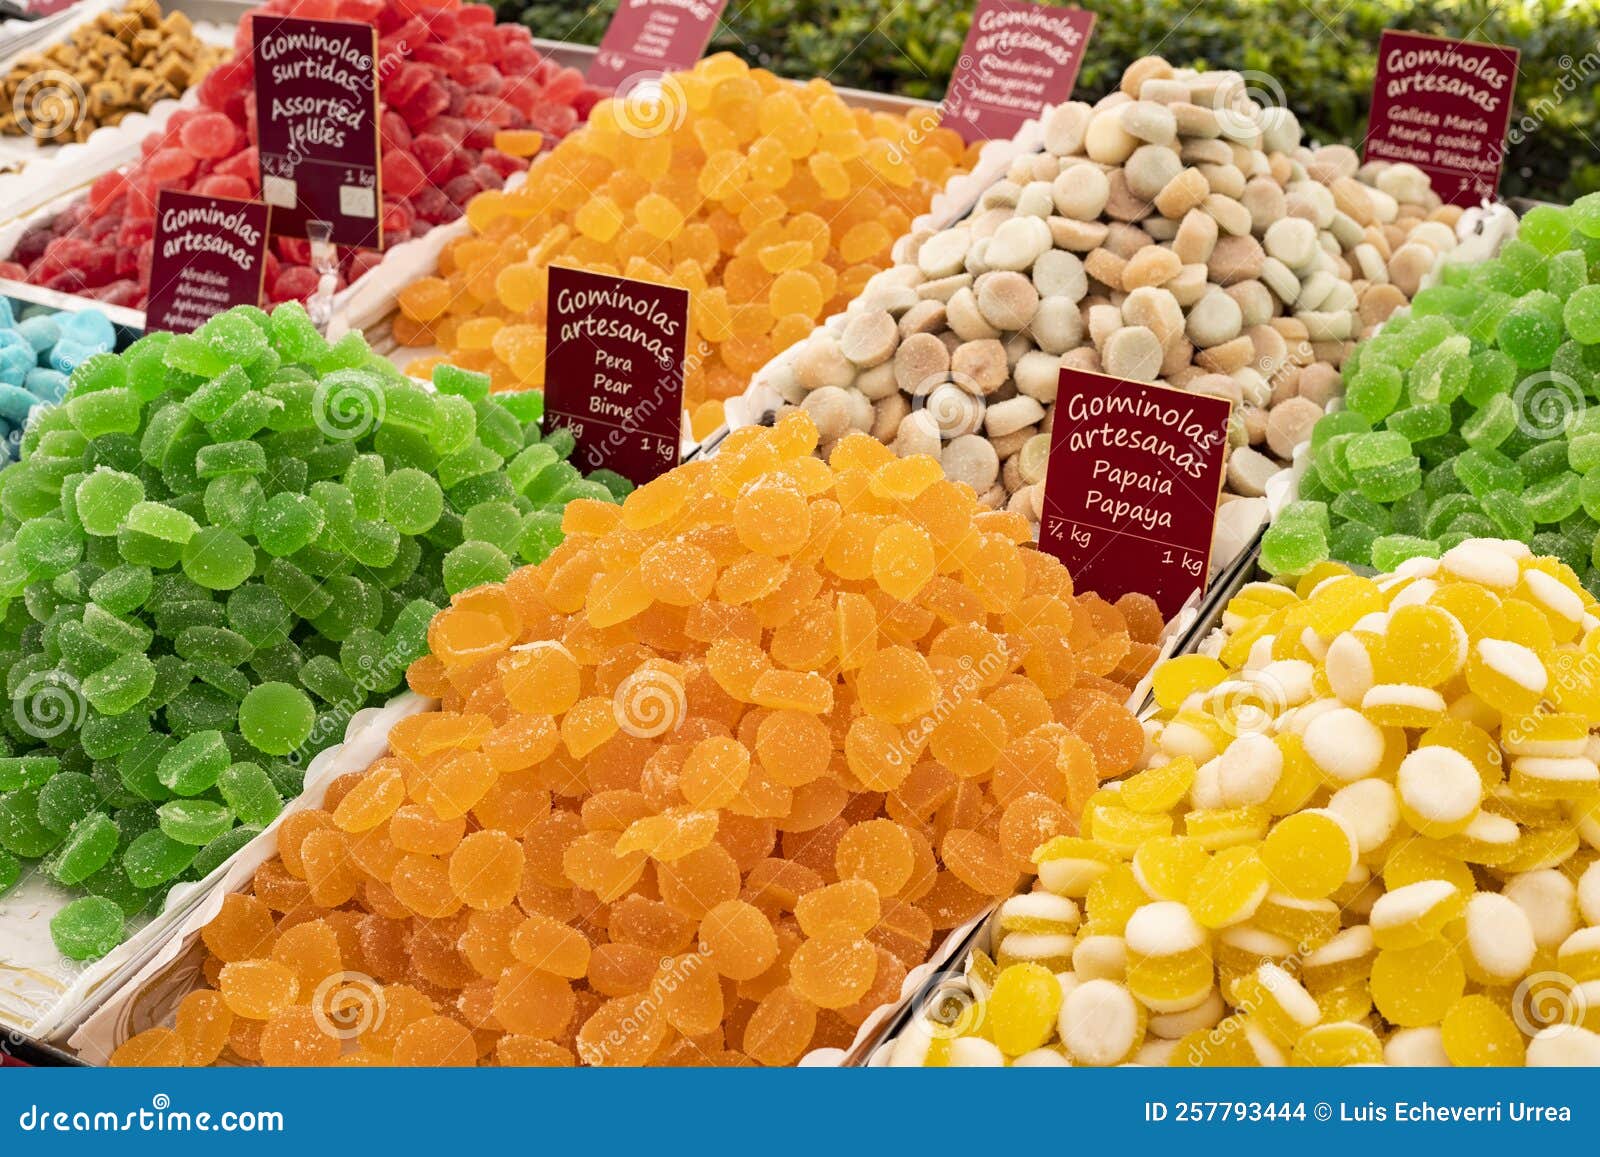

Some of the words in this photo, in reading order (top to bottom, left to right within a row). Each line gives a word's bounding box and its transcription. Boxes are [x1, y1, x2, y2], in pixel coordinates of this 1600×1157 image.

[978, 6, 1083, 46] Gominolas
[976, 29, 1073, 66] artesanas
[272, 55, 361, 91] surtidas
[1386, 43, 1509, 90] Gominolas
[1386, 70, 1501, 113] artesanas
[272, 96, 366, 131] Assorted
[287, 118, 346, 149] jellies
[162, 201, 261, 247] Gominolas
[163, 230, 255, 271] artesanas
[557, 284, 680, 337] Gominolas
[561, 314, 674, 363] artesanas
[595, 349, 633, 373] Pera
[593, 373, 633, 395] Pear
[589, 396, 633, 420] Birne
[1068, 390, 1218, 451] Gominolas
[567, 417, 584, 439] kg
[640, 437, 651, 451] 1
[657, 439, 674, 461] kg
[1070, 422, 1208, 479] artesanas
[1092, 459, 1173, 496] Papaia
[1085, 490, 1172, 530] Papaya
[1070, 525, 1092, 549] kg
[1162, 550, 1174, 564] 1
[1181, 552, 1203, 577] kg
